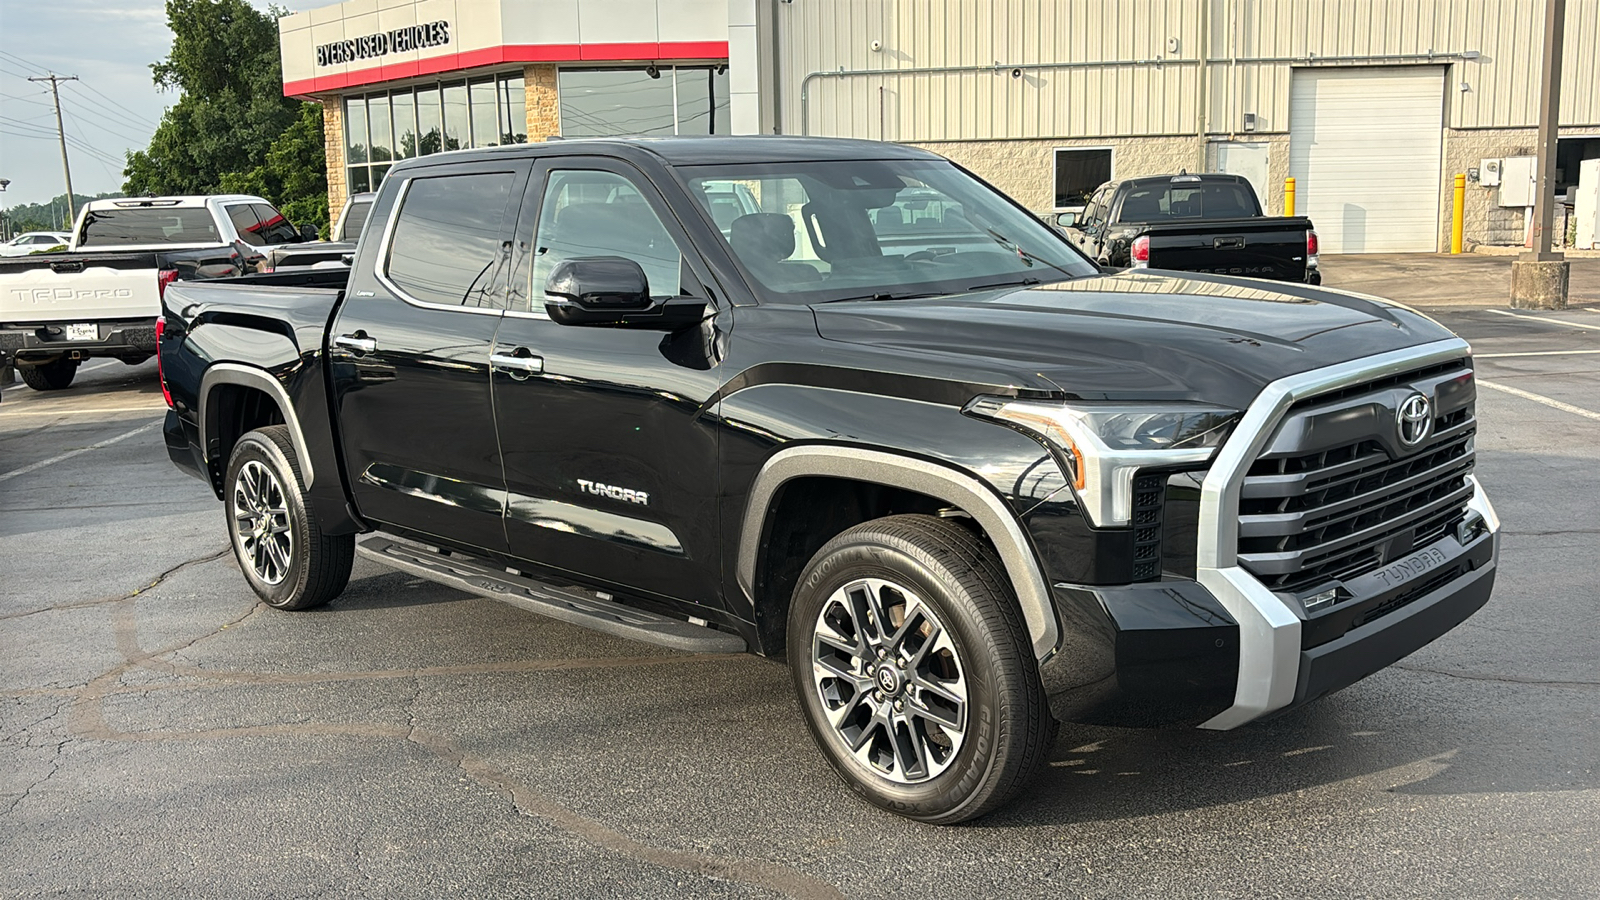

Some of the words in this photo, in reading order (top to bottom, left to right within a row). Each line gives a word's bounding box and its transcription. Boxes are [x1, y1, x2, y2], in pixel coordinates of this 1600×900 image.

[316, 40, 354, 66] BYERS
[354, 33, 388, 59] USED
[387, 20, 449, 53] VEHICLES
[1184, 266, 1274, 274] ACOMA
[577, 478, 648, 506] TUNDRA
[1373, 547, 1447, 587] TUNDRA
